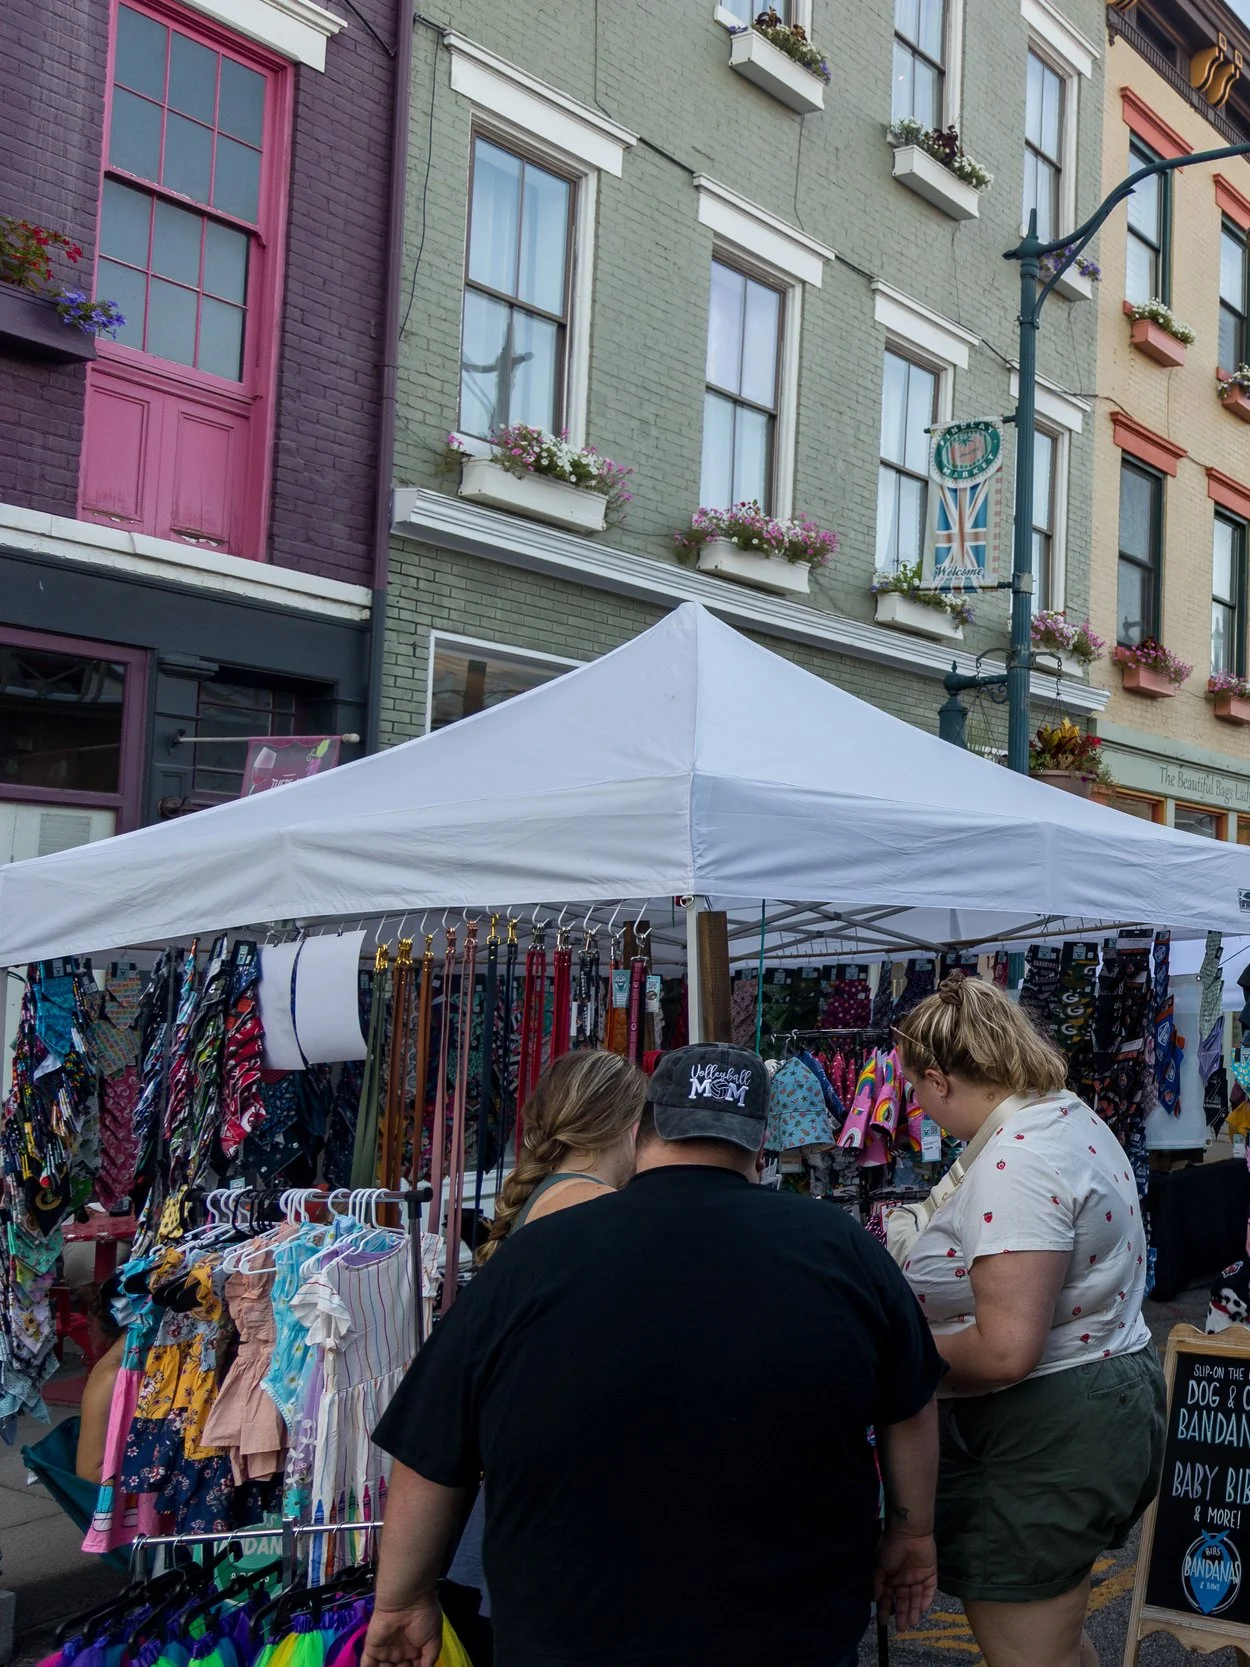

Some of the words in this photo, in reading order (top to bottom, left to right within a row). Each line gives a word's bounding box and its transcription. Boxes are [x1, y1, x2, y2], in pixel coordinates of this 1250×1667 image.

[940, 422, 994, 446] FINDLAY
[942, 453, 994, 478] MARKET
[935, 564, 984, 577] Welcome
[1160, 766, 1175, 787] The
[1177, 771, 1214, 799] Beautiful
[1216, 780, 1234, 804] Bags
[691, 1063, 752, 1086] Volleyball
[1193, 1364, 1225, 1379] SLIP-ON
[1228, 1367, 1245, 1381] THE
[1187, 1379, 1220, 1408] DOG
[1227, 1385, 1237, 1409] &
[1172, 1460, 1219, 1501] BABY
[1193, 1504, 1202, 1522] &
[1207, 1506, 1241, 1530] MORE!
[1205, 1546, 1221, 1556] BIBS
[1184, 1555, 1241, 1585] BANDANAS
